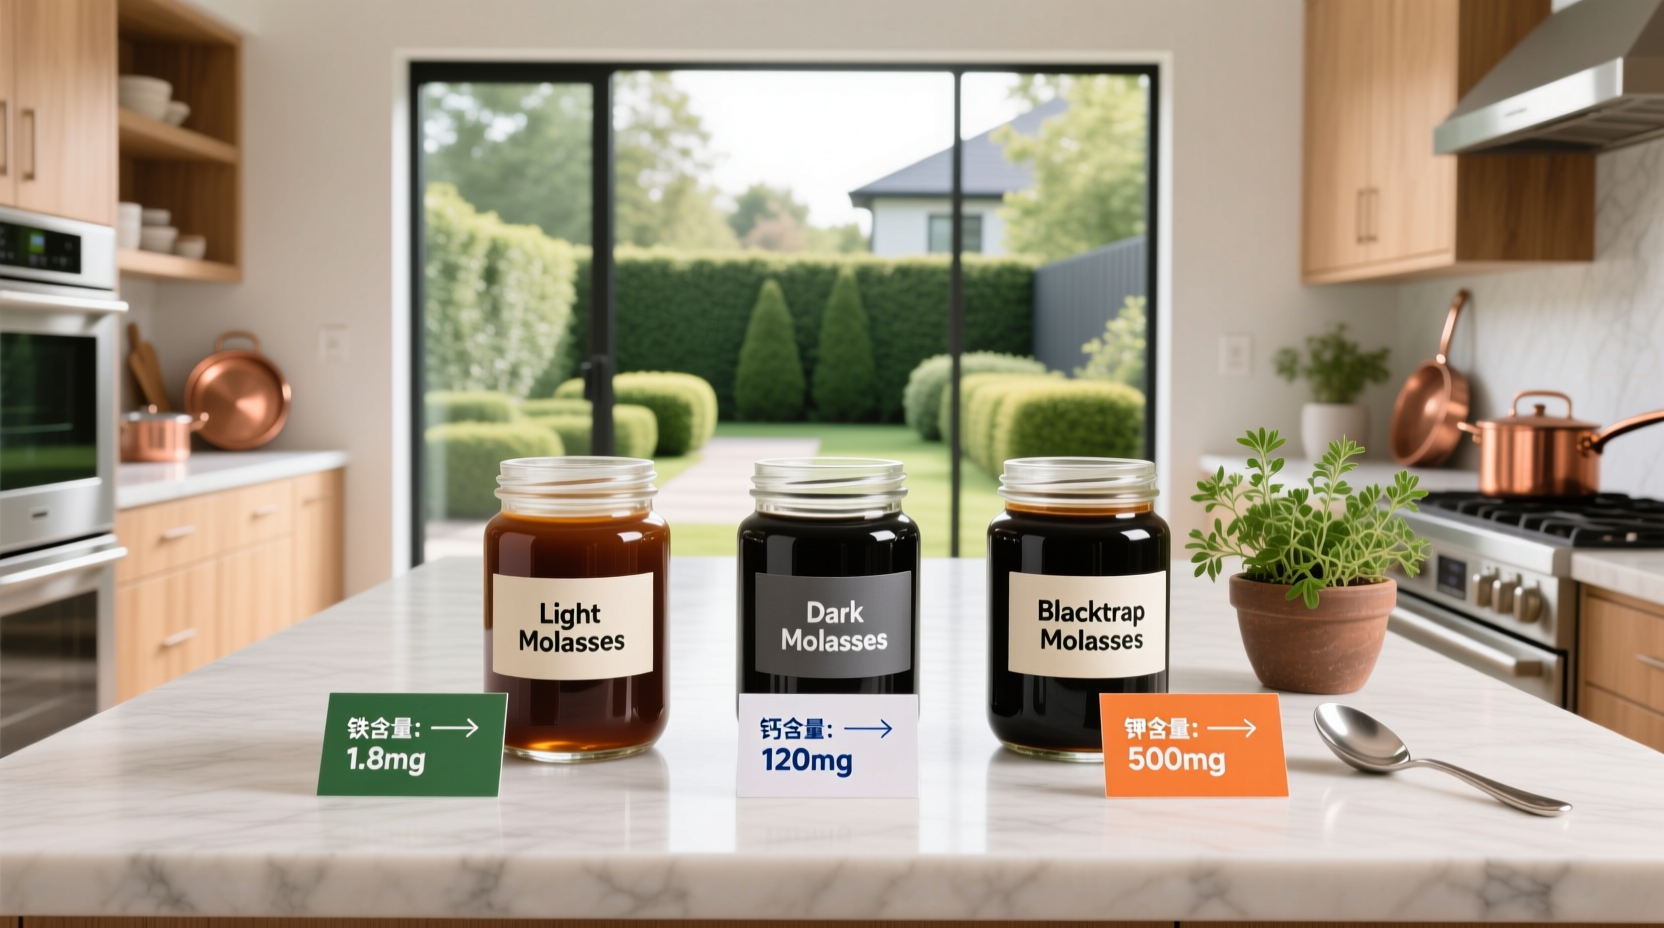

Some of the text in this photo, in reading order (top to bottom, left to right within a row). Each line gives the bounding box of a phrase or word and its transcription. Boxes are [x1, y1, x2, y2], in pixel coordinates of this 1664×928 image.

[540, 601, 601, 630] Light
[806, 600, 864, 624] Dark
[1038, 599, 1145, 627] Blacktrap
[519, 630, 625, 653] Molasses
[781, 628, 888, 652] Molasses
[1040, 628, 1144, 652] Molasses
[347, 746, 426, 776] 1.8mg
[762, 748, 853, 777] 120mg
[1128, 747, 1226, 777] 500mg
